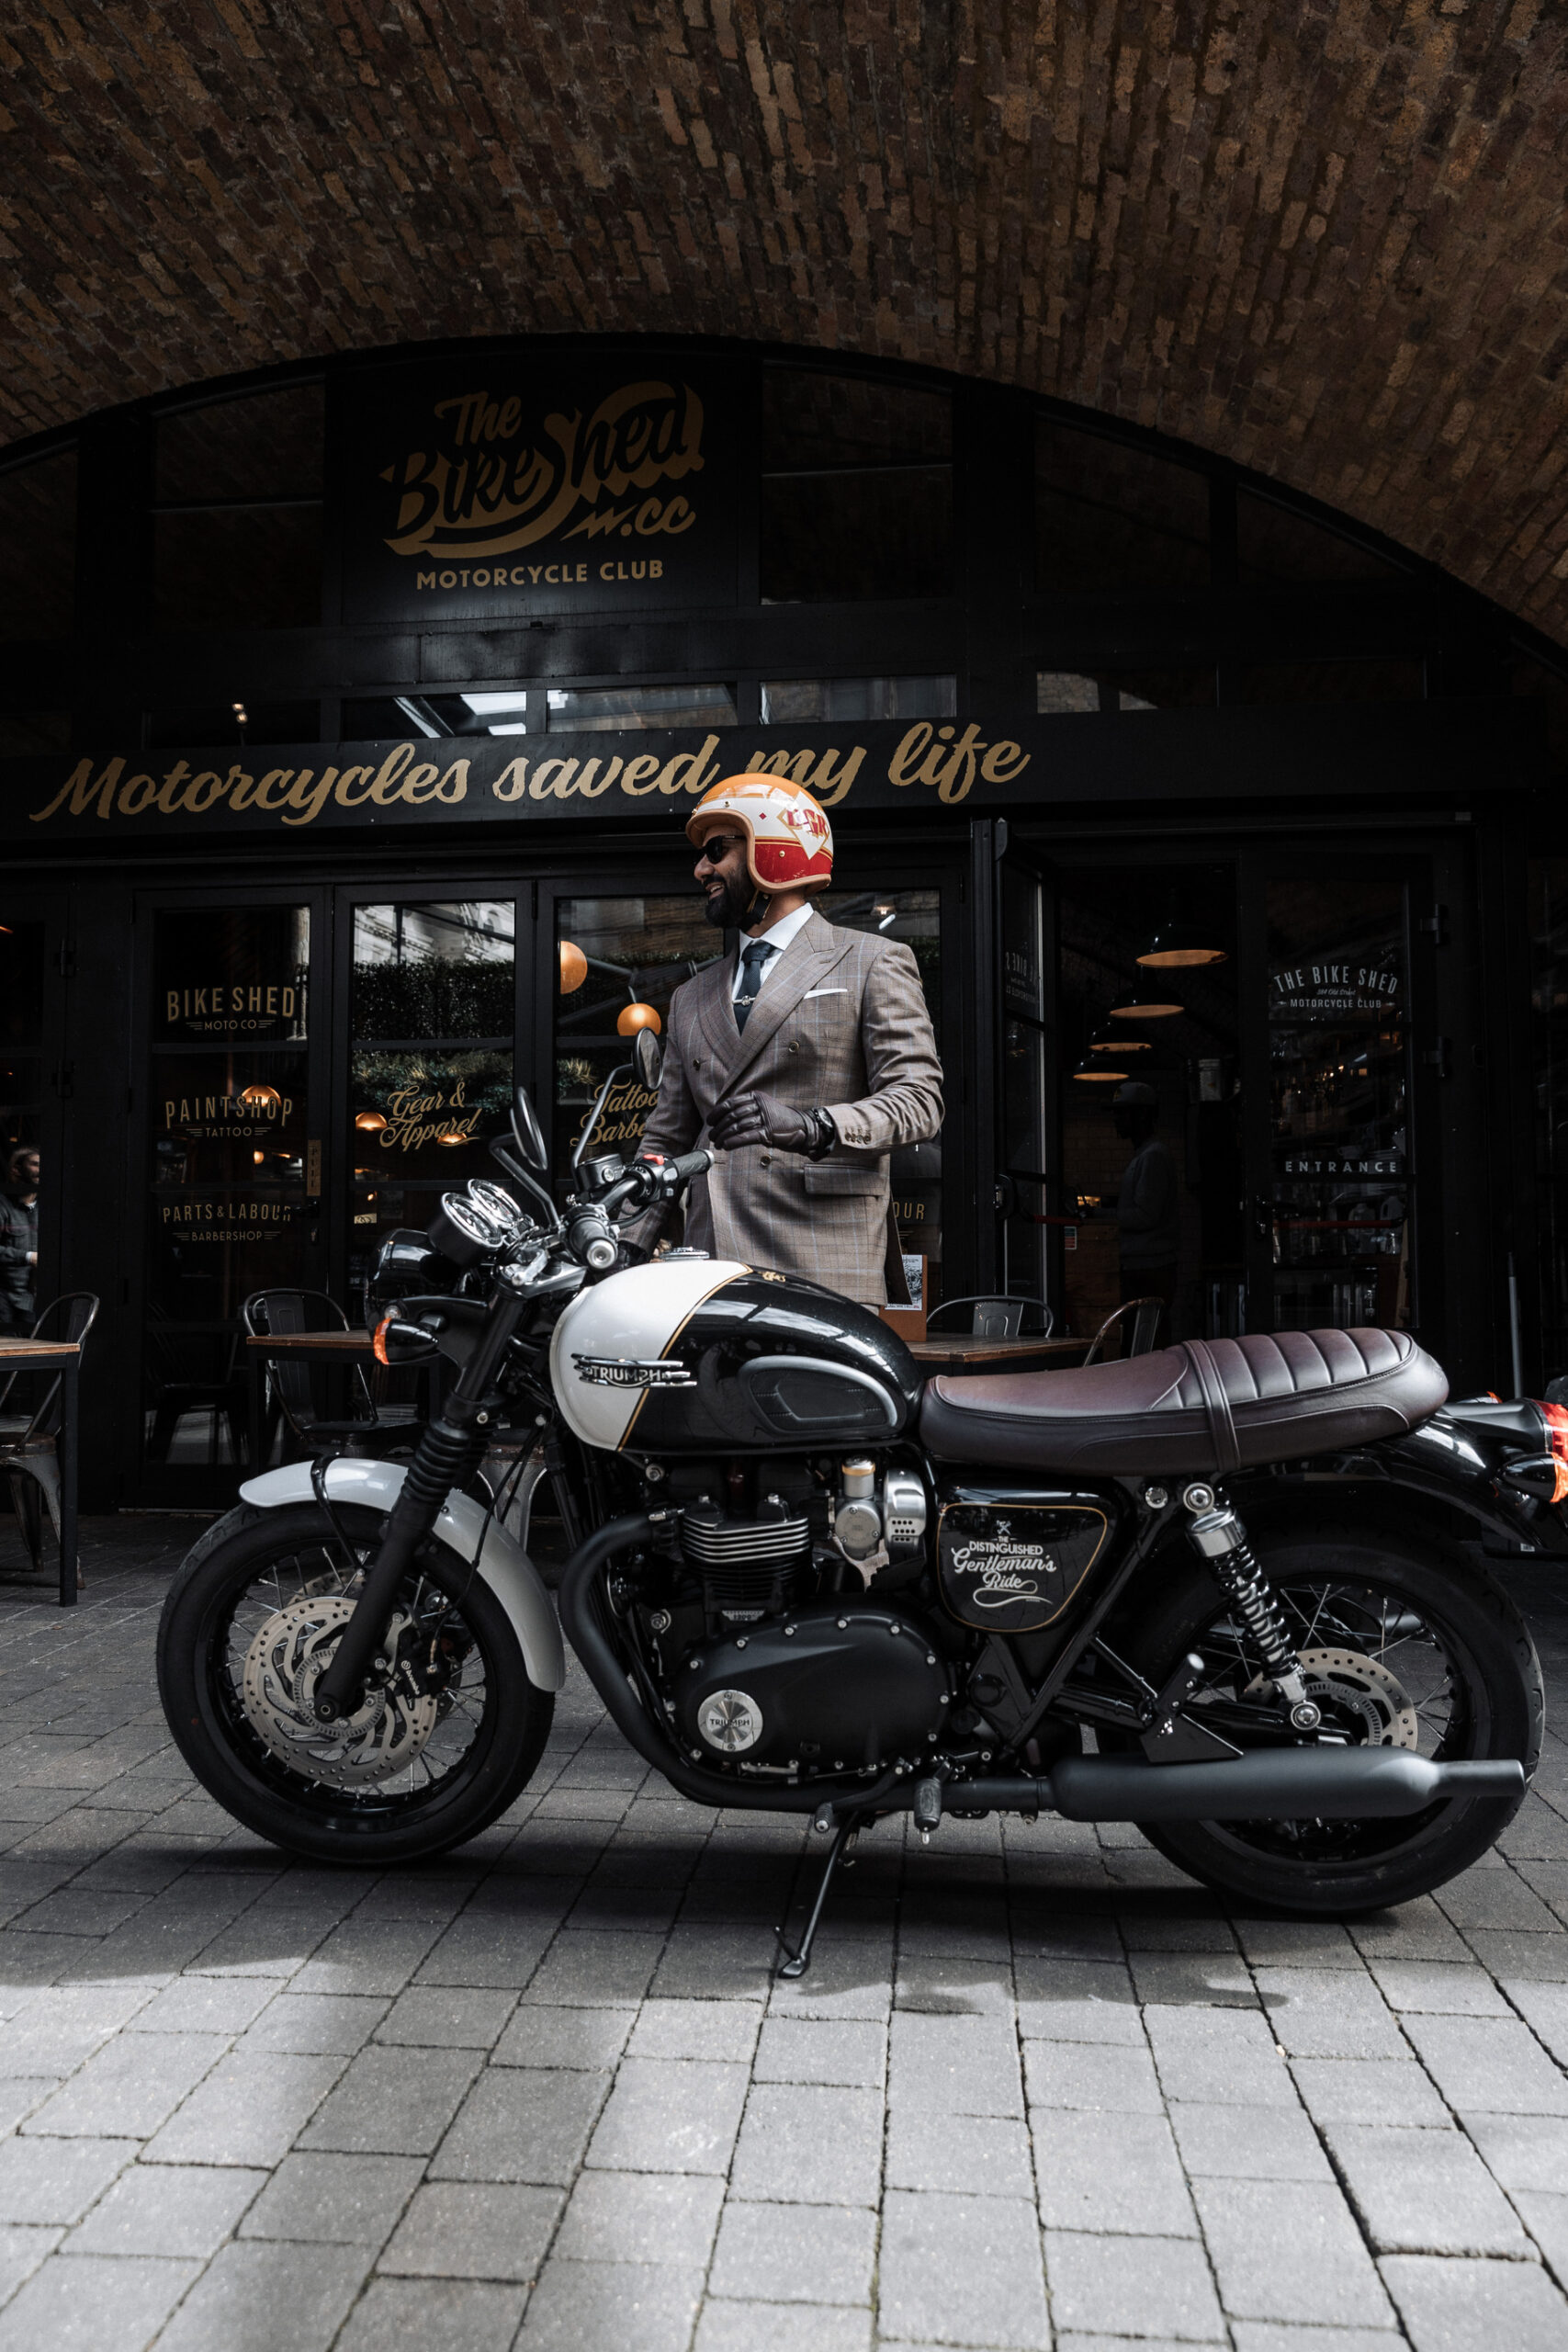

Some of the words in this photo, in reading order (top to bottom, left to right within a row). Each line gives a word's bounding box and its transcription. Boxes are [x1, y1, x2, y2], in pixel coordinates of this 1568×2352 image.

[434, 390, 522, 447] The
[416, 563, 588, 590] MOTORCYCLE
[599, 560, 664, 582] CLUB
[30, 741, 471, 825] Motorcycles
[492, 734, 721, 803] saved
[747, 744, 868, 807] my
[887, 721, 1032, 804] life
[1273, 969, 1304, 992] THE
[1312, 966, 1349, 984] BIKE
[1359, 968, 1398, 994] SHED
[167, 988, 224, 1023] BIKE
[231, 986, 296, 1019] SHED
[1290, 999, 1353, 1008] MOTORCYCLE
[1358, 999, 1382, 1009] CLUB
[204, 1019, 238, 1031] MOTO
[240, 1019, 257, 1030] CO
[164, 1095, 294, 1129] PAINTSHOP
[387, 1085, 445, 1120] Gear
[449, 1081, 466, 1107] &
[206, 1125, 253, 1137] TATTOO
[379, 1107, 481, 1152] Apparel
[570, 1107, 647, 1148] Barbe
[1284, 1159, 1398, 1173] ENTRANCE
[163, 1204, 212, 1224] PARTS
[216, 1206, 225, 1219] &
[191, 1230, 263, 1242] BARBERSHOP
[591, 1365, 661, 1385] TRIUMPH
[969, 1540, 1043, 1556] DISTINGUISHED
[998, 1535, 1010, 1544] THE
[951, 1546, 1057, 1574] Gentleman's
[982, 1571, 1023, 1589] Ride
